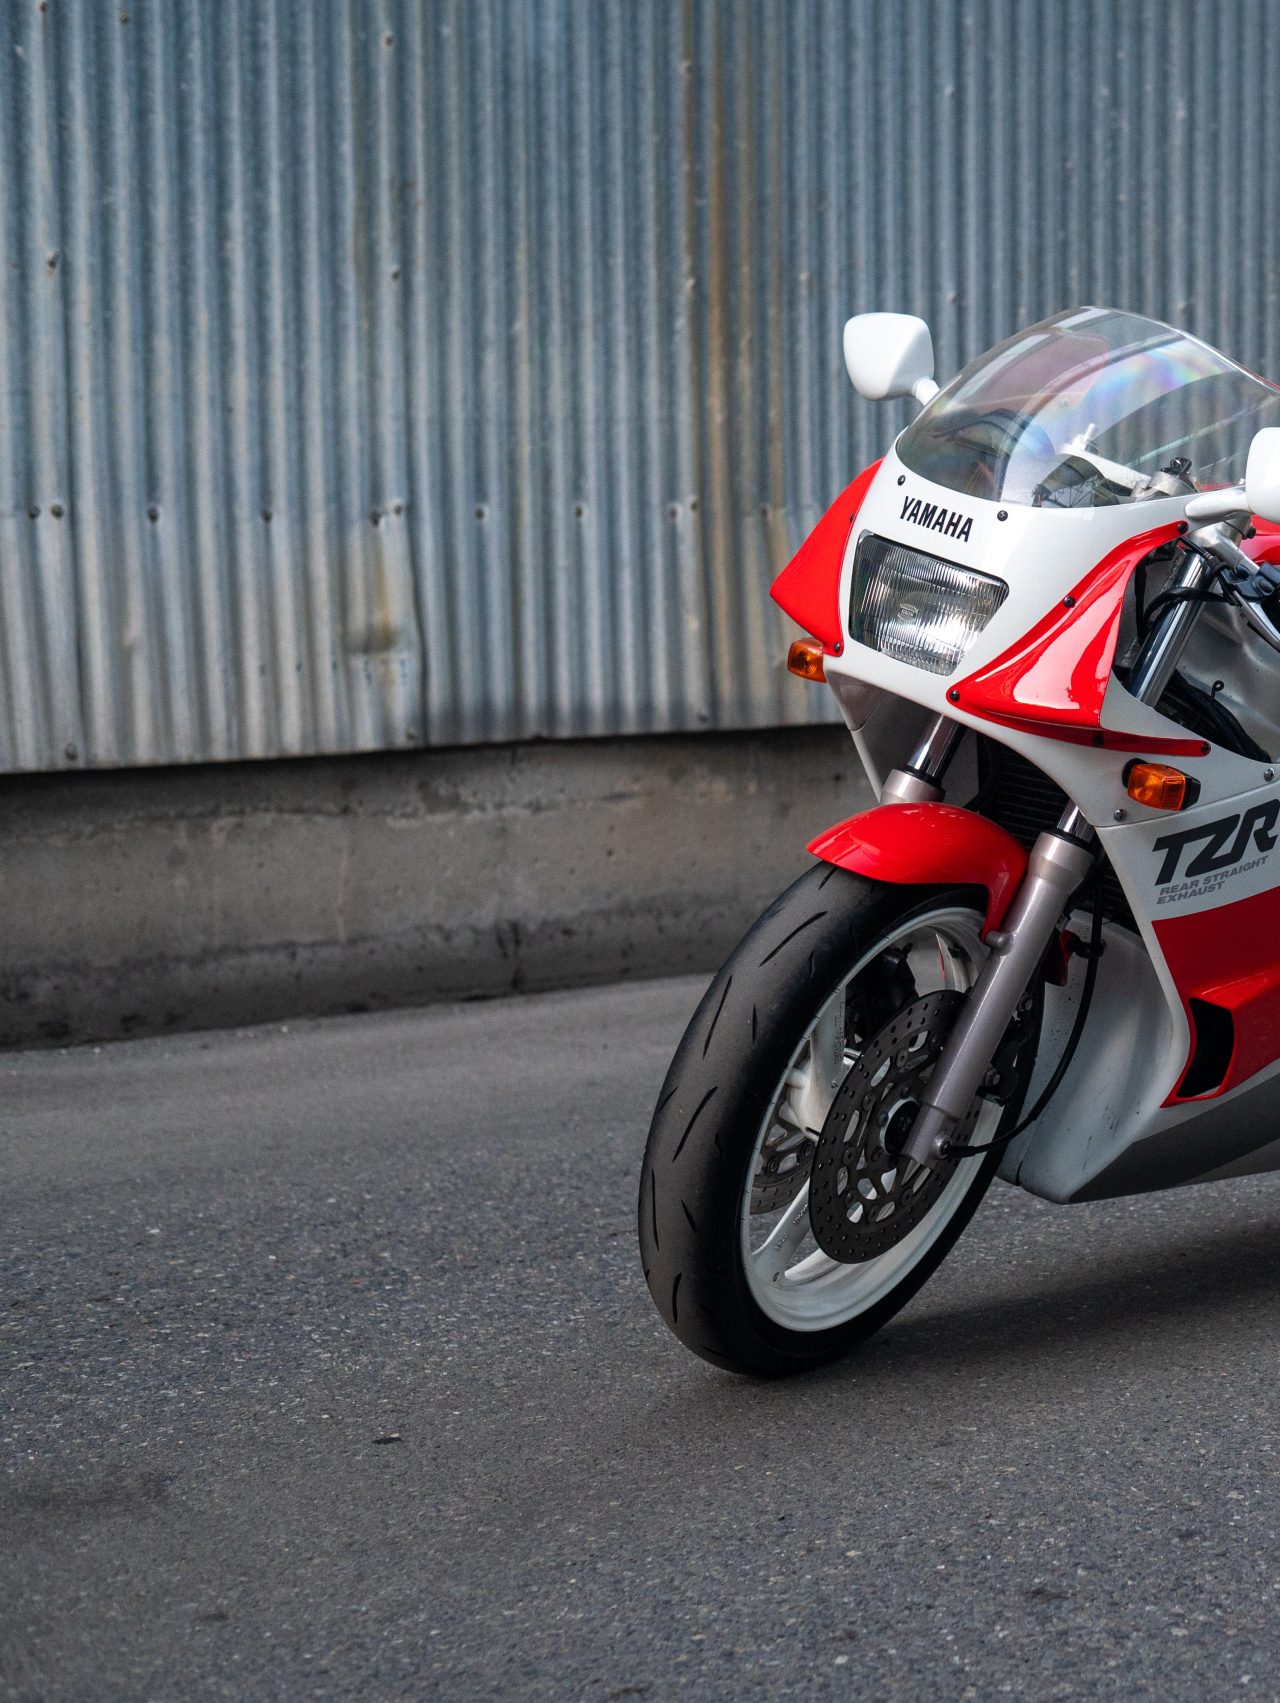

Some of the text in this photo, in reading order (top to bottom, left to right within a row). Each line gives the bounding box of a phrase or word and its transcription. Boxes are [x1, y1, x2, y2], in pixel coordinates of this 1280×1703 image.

[900, 495, 974, 543] YAMAHA
[1152, 799, 1280, 886] TZR
[1156, 881, 1225, 905] EXHAUST
[1160, 855, 1269, 896] REAR STRAIGHT
